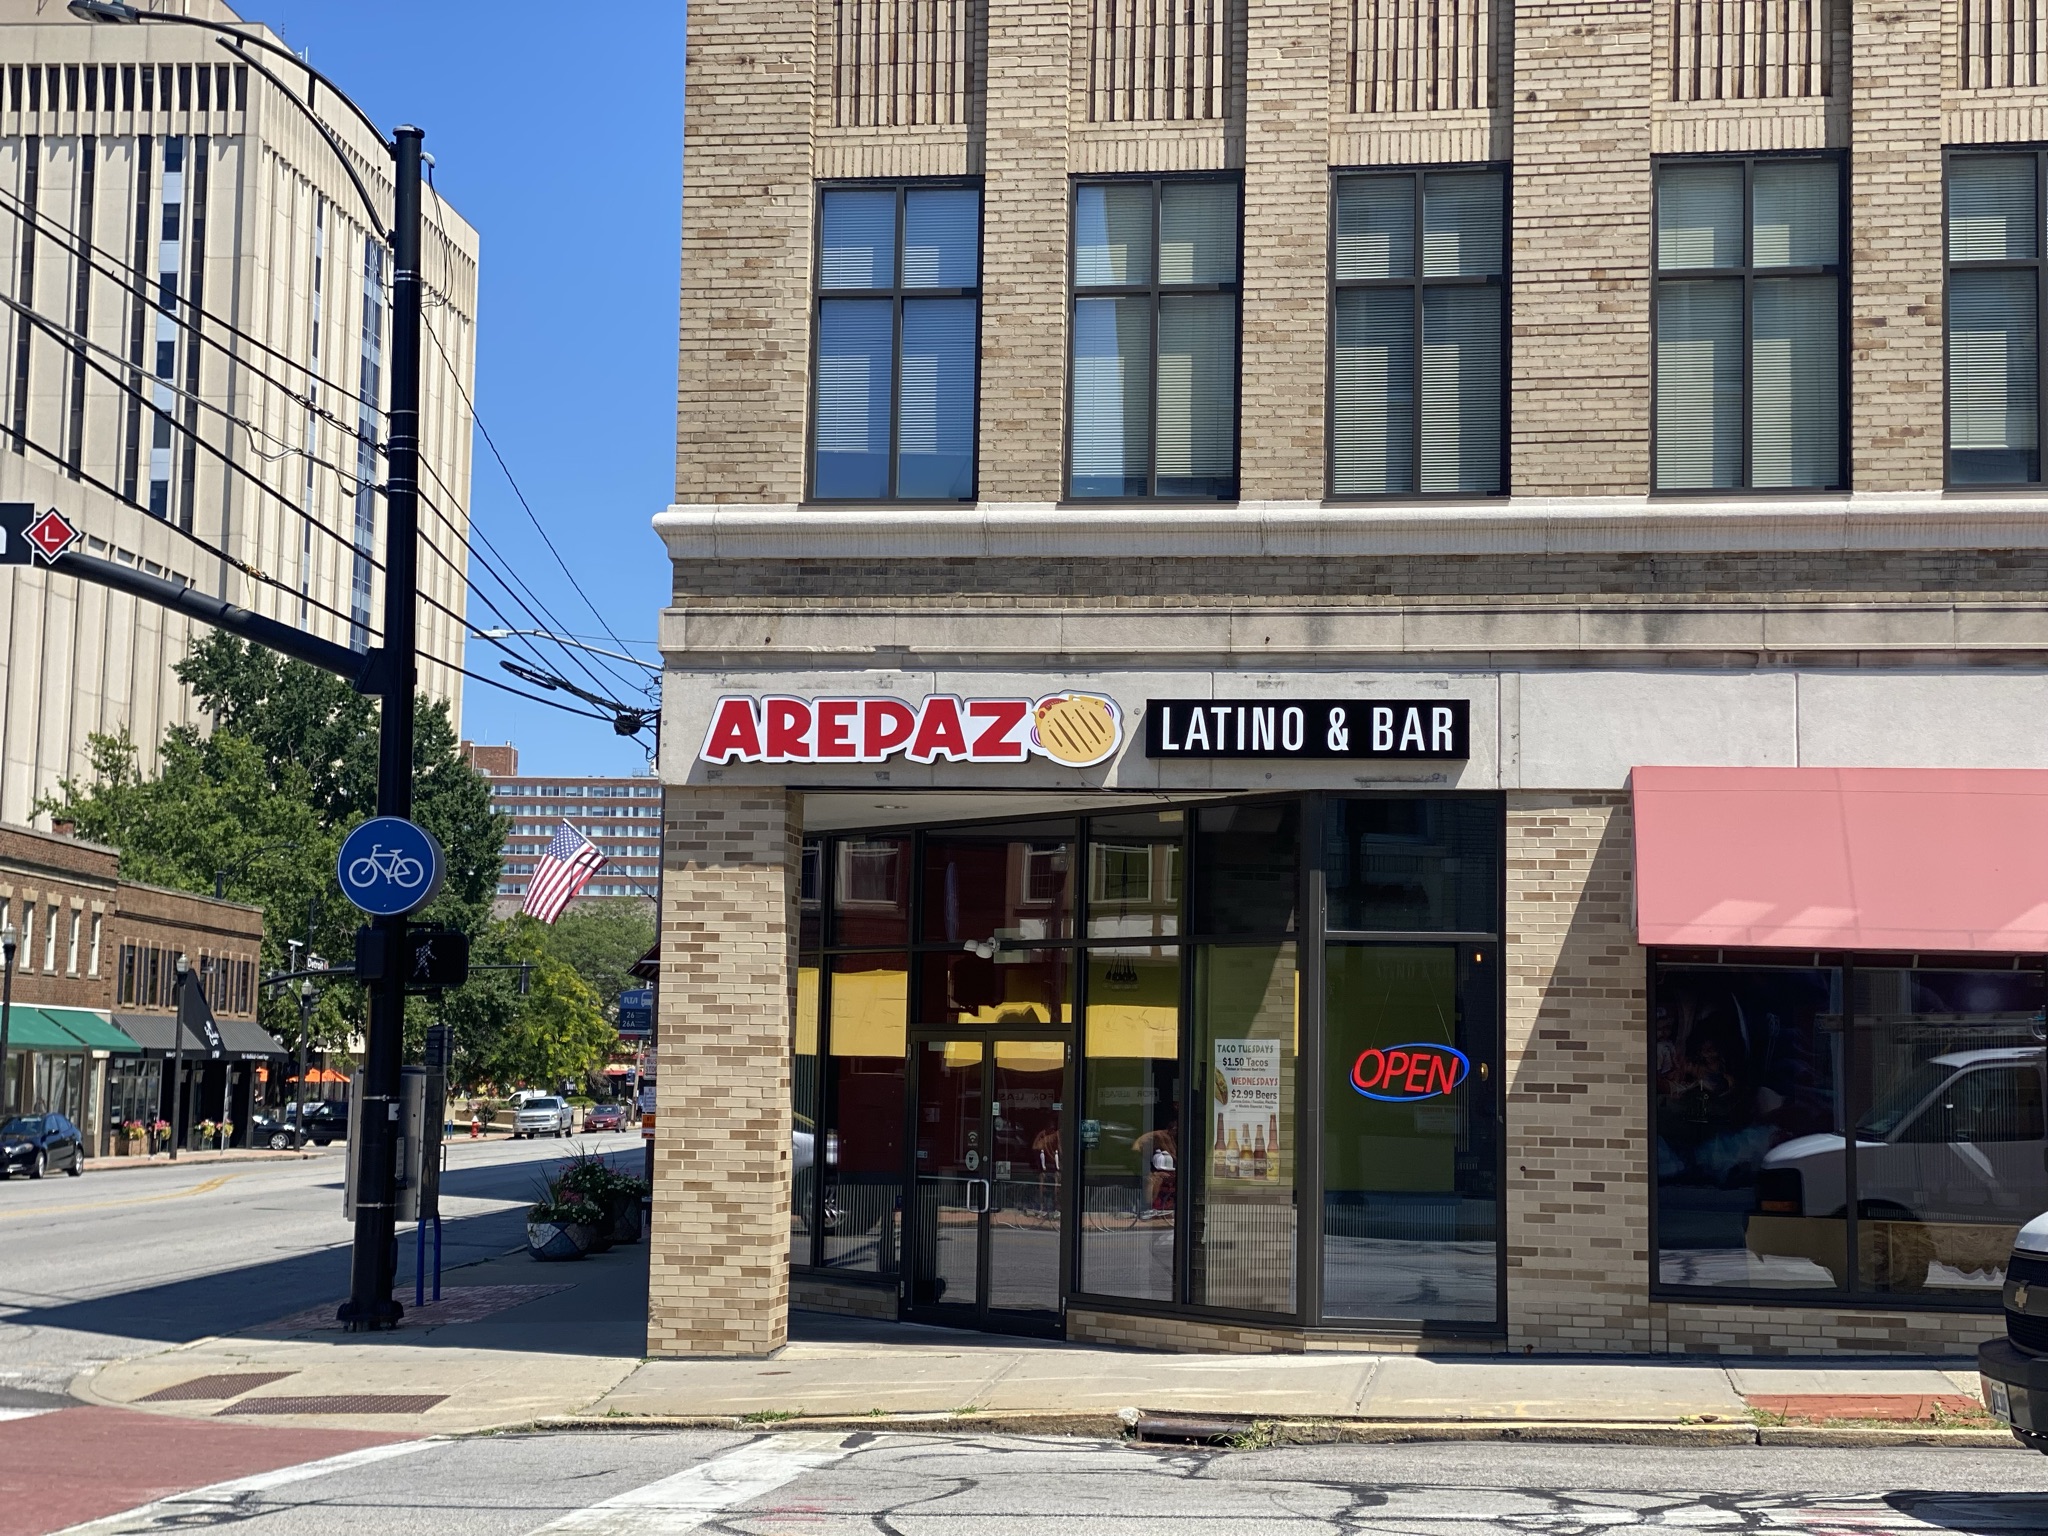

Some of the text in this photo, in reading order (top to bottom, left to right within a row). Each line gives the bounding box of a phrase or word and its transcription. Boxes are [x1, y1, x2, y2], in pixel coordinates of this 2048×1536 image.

[1162, 706, 1453, 750] LATINO & BAR
[1217, 1044, 1274, 1054] TACO TUESDAYS
[1222, 1057, 1268, 1067] $1.50 Tacos
[1354, 1048, 1459, 1094] OPEN
[1231, 1076, 1278, 1086] WEDNESDAYS
[1231, 1089, 1277, 1099] $2.99 Beers
